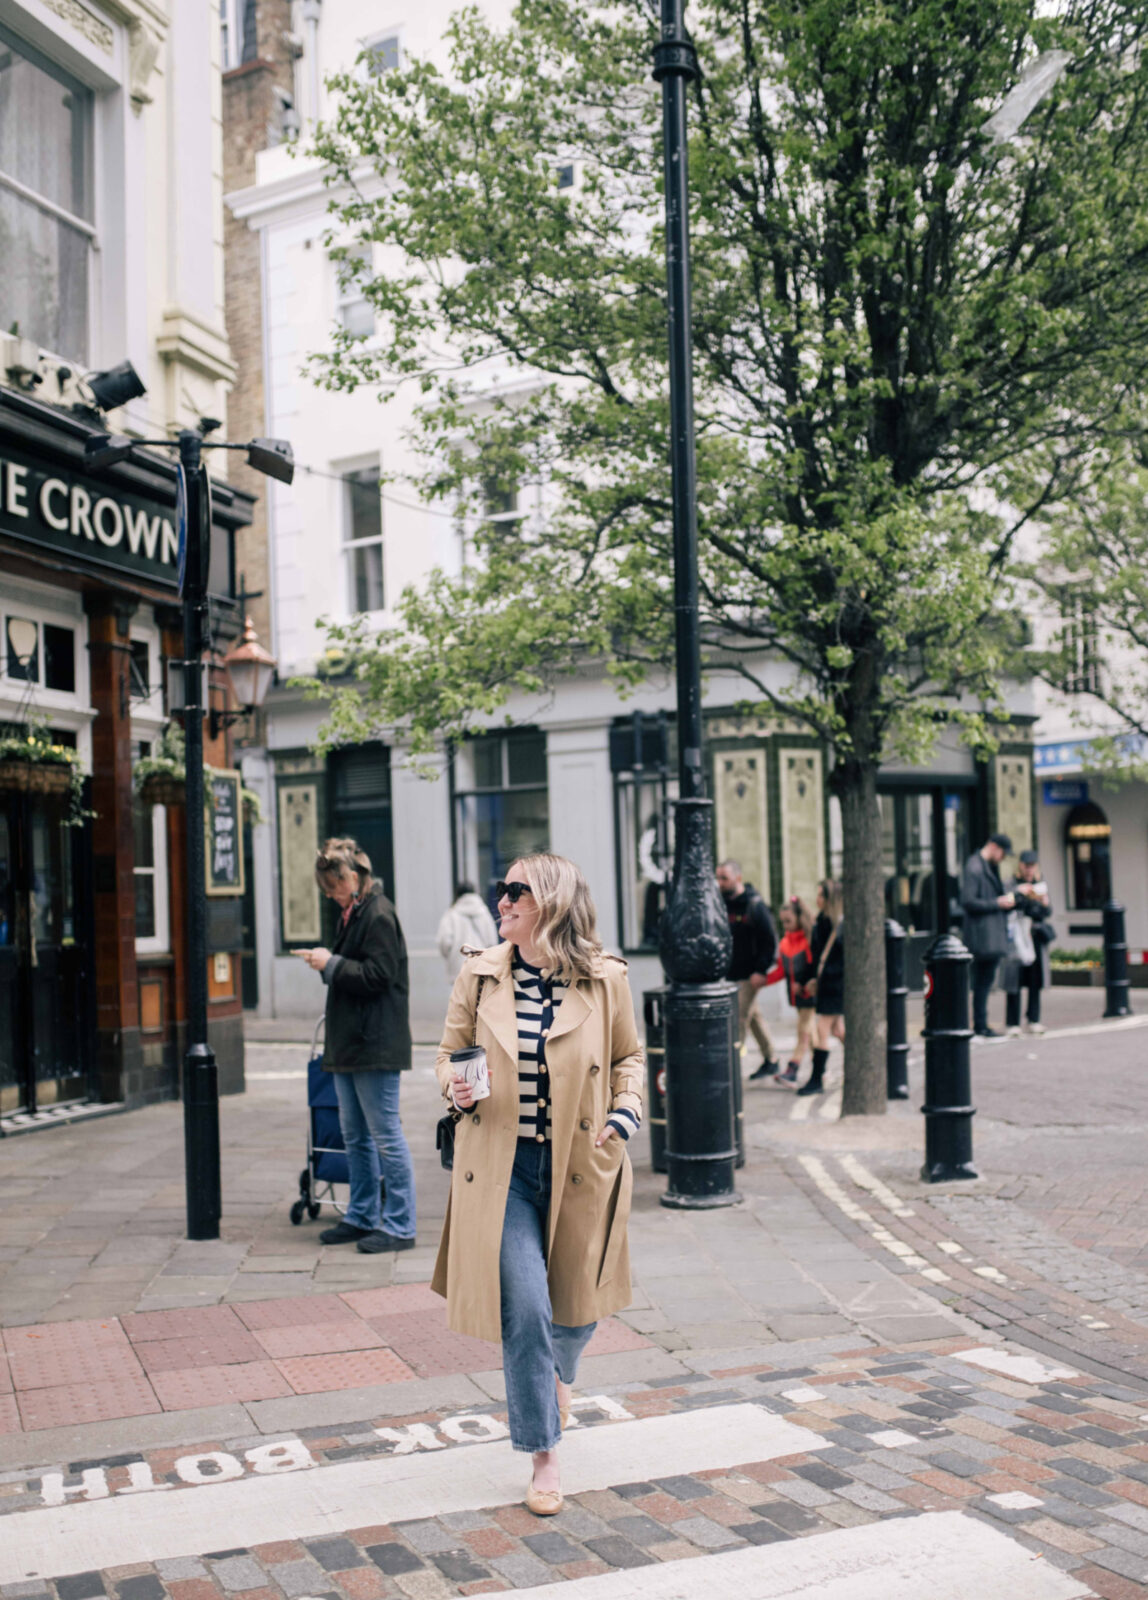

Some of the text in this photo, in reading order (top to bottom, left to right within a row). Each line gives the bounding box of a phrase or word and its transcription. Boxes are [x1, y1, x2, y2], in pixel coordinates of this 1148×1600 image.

[0, 459, 179, 564] E CROWN
[373, 1394, 635, 1455] LOK
